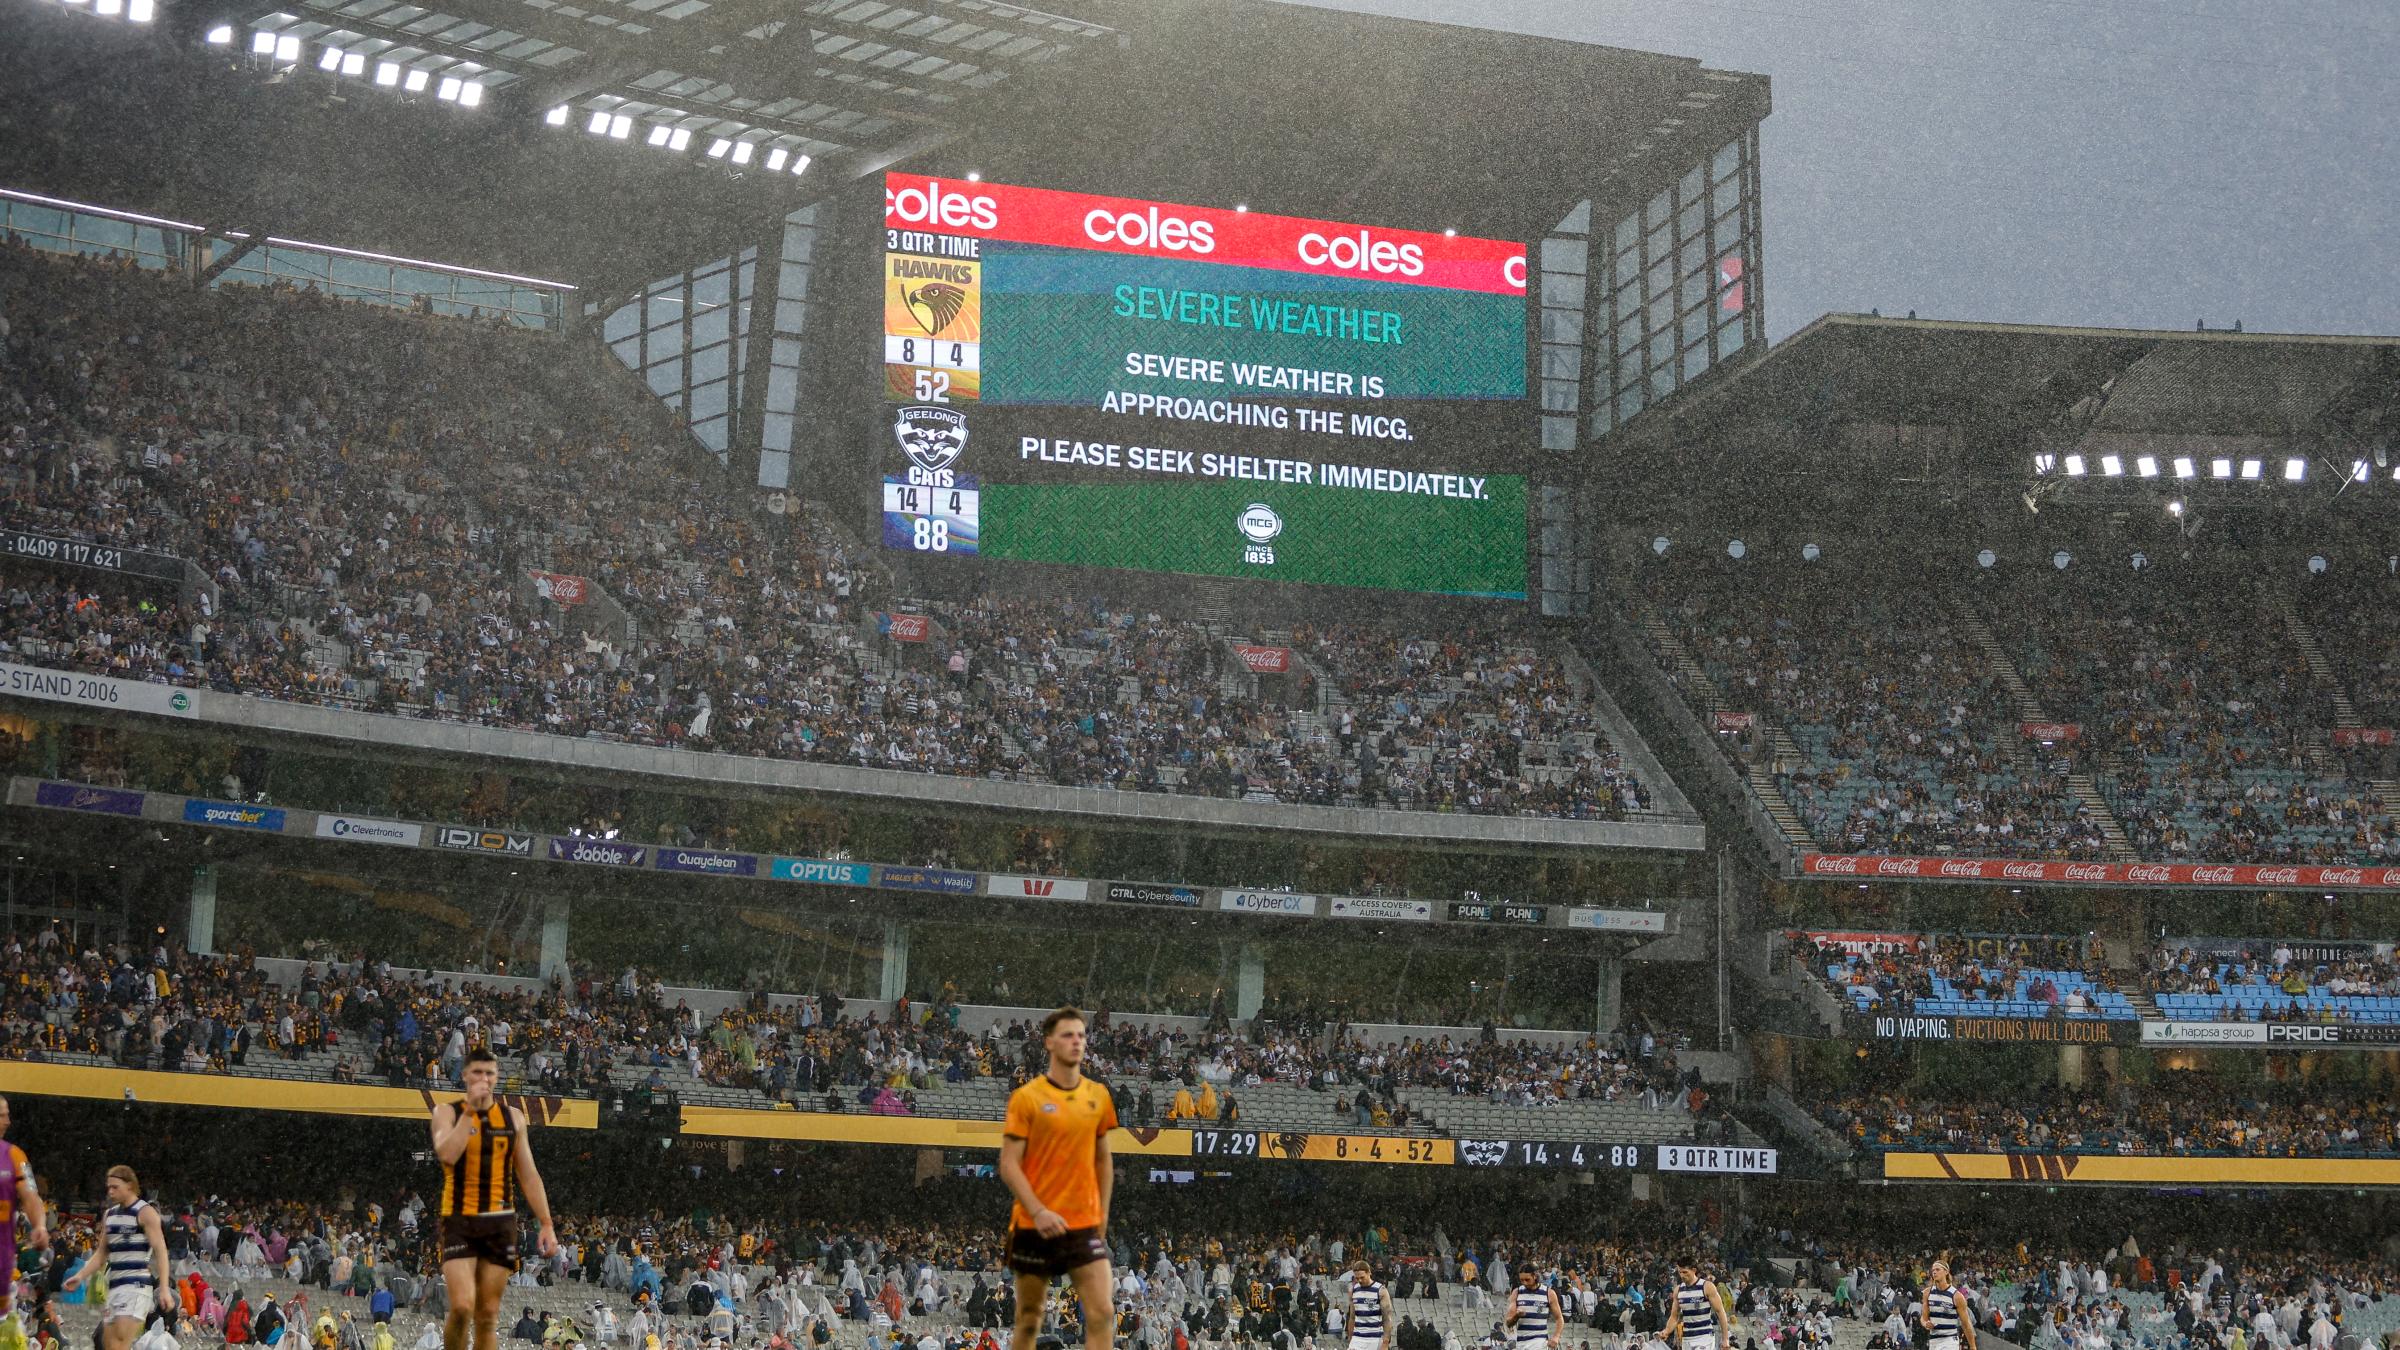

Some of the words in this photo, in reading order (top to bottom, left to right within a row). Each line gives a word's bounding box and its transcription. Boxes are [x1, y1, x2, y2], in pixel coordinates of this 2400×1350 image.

[1084, 207, 1215, 254] coles
[888, 230, 898, 249] 3
[902, 231, 934, 254] QTR
[938, 235, 980, 258] TIME
[1298, 231, 1423, 276] coles
[893, 258, 973, 285] HAWKS
[1114, 284, 1242, 328] SEVERE
[1250, 298, 1403, 345] WEATHER
[903, 338, 915, 363] 8
[950, 343, 963, 367] 4
[915, 369, 950, 403] 52
[1125, 352, 1225, 383] SEVERE
[1231, 362, 1353, 396] WEATHER
[1361, 375, 1385, 399] IS
[905, 410, 958, 424] GEELONG
[1101, 390, 1288, 430] APPROACHING
[1295, 408, 1344, 434] THE
[1351, 414, 1414, 441] MCG.
[908, 465, 954, 488] CATS
[1021, 437, 1121, 467] PLEASE
[1127, 445, 1195, 474] SEEK
[1201, 454, 1313, 485] SHELTER
[1320, 463, 1490, 500] IMMEDIATELY.
[896, 487, 919, 512] 14
[949, 491, 962, 516] 4
[1246, 517, 1273, 528] MCG
[914, 518, 949, 552] 88
[17, 536, 58, 558] 0409
[63, 543, 90, 563] 117
[94, 551, 122, 569] 621
[1244, 551, 1275, 565] 1853
[1246, 545, 1273, 553] SINCE
[12, 670, 72, 696] STAND
[78, 679, 118, 703] 2006
[204, 808, 260, 824] sportsbet
[352, 824, 404, 839] Clevertronics
[440, 828, 530, 852] IDIOM
[572, 841, 623, 864] dabble
[677, 852, 737, 869] Quayclean
[790, 862, 852, 881] OPTUS
[1110, 888, 1136, 899] CTRL
[1137, 889, 1201, 905] Cybersecurity
[1247, 894, 1302, 911] CyberCX
[1351, 900, 1380, 909] ACCESS
[1382, 901, 1413, 910] COVERS
[1359, 909, 1401, 918] AUSTRALIA
[1875, 1017, 1895, 1037] NO
[1899, 1017, 1951, 1039] VAPING.
[1955, 1019, 2023, 1041] EVICTIONS
[2028, 1020, 2061, 1042] WILL
[2064, 1021, 2113, 1043] OCCUR.
[2181, 1025, 2220, 1039] happsa
[2223, 1027, 2255, 1040] group
[2269, 1025, 2339, 1041] PRIDE
[1194, 1132, 1256, 1155] 17:29
[1408, 1140, 1434, 1162] 52
[1522, 1143, 1548, 1164] 14
[1611, 1146, 1638, 1167] 88
[1669, 1148, 1678, 1168] 3
[1685, 1149, 1718, 1169] QTR
[1724, 1149, 1768, 1170] TIME
